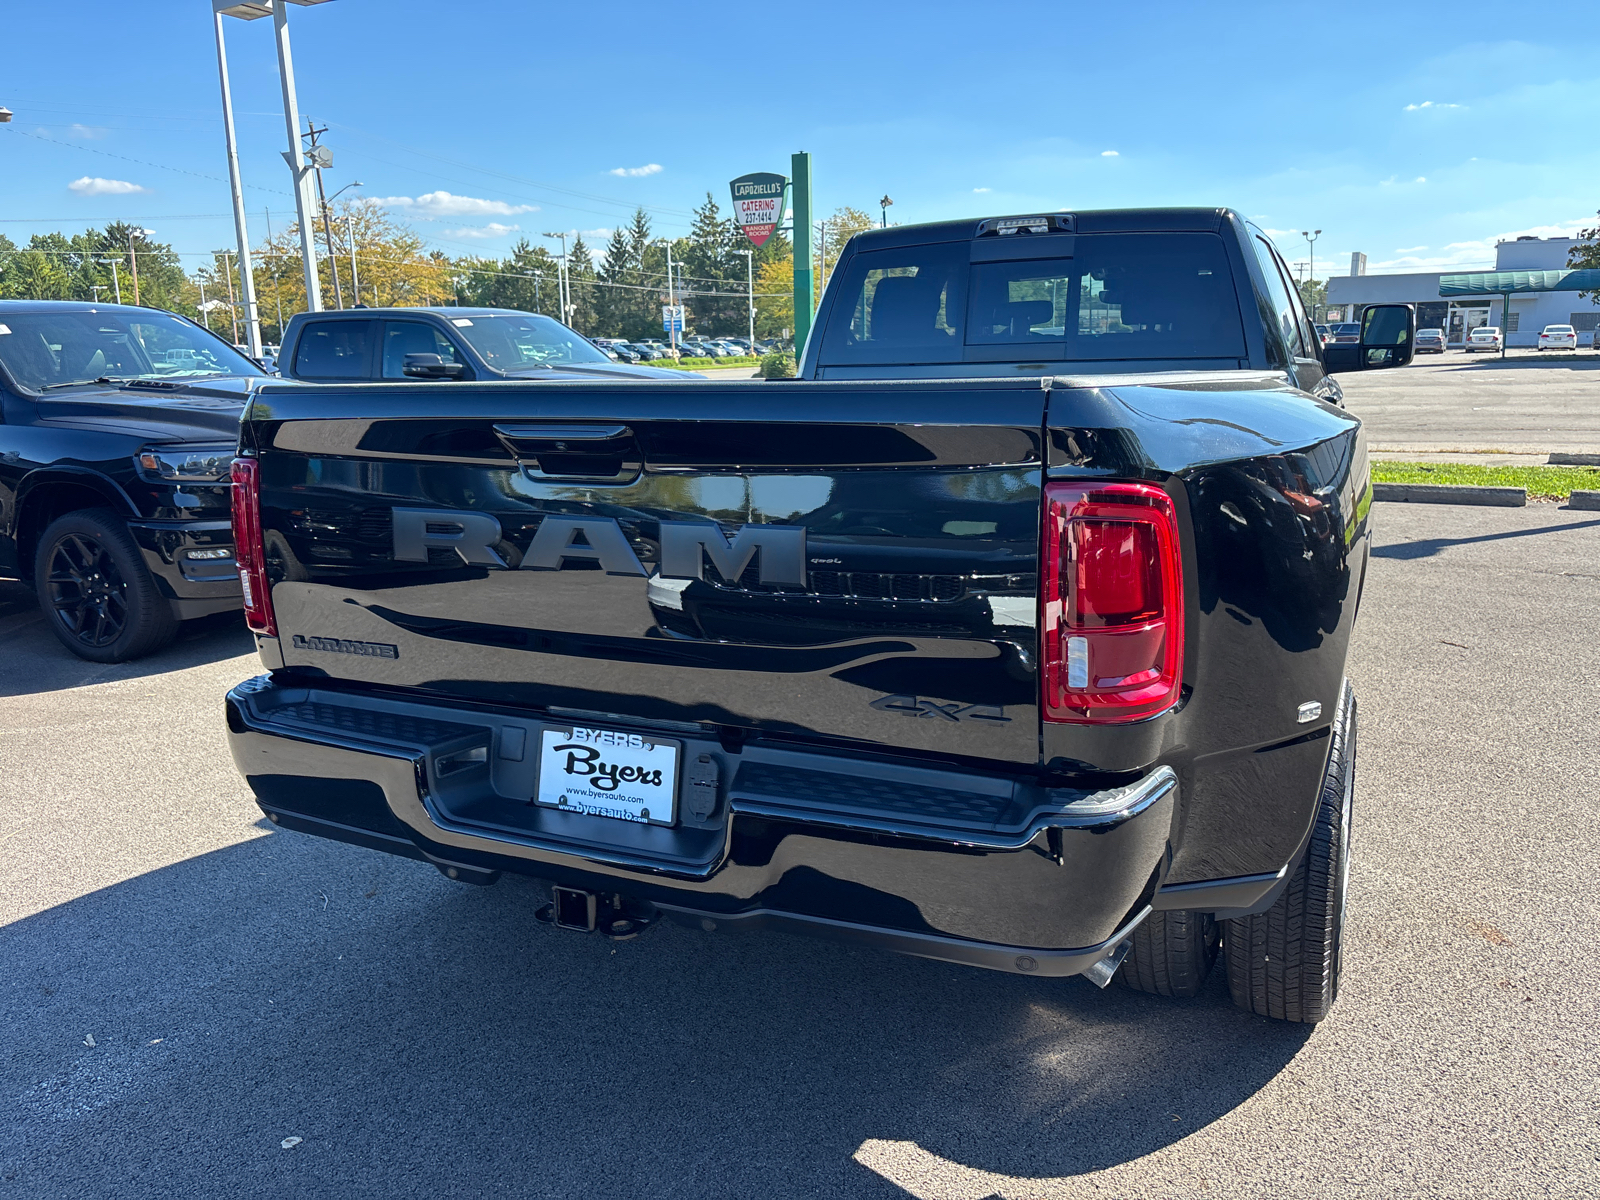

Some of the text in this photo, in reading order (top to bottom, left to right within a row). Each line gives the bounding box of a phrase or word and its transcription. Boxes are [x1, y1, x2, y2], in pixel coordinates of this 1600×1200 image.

[742, 200, 774, 212] CATERING
[745, 212, 772, 223] 237-1414
[391, 506, 807, 588] RAM
[571, 727, 644, 749] BYERS
[552, 744, 662, 791] Byers
[566, 786, 644, 804] www.byersauto.com
[558, 801, 648, 823] www.byersauto.com
